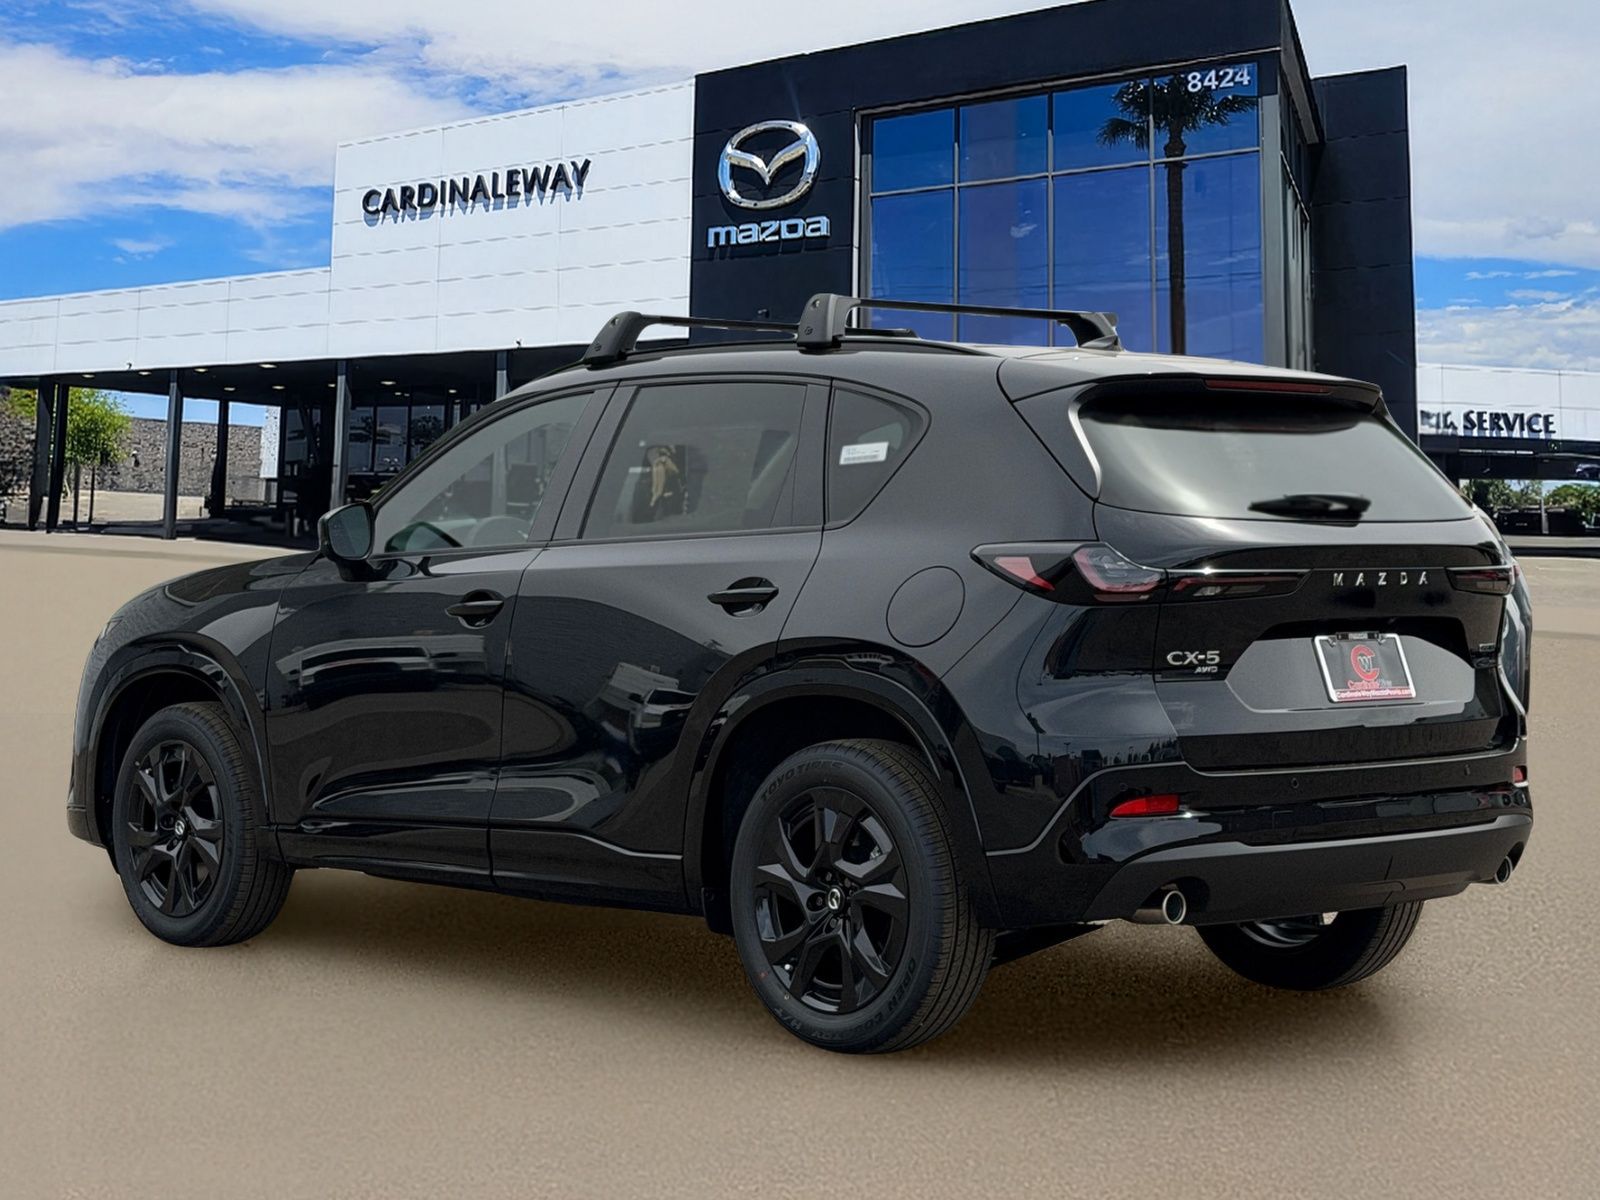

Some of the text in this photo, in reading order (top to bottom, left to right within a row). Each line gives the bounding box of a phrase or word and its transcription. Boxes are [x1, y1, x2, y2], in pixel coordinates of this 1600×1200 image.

[1187, 65, 1251, 93] 8424
[361, 158, 592, 218] CARDINALEWAY
[707, 215, 830, 248] mazda
[1462, 409, 1557, 434] SERVICE
[1332, 571, 1428, 586] MAZDA
[1166, 650, 1221, 666] CX-5
[1194, 665, 1219, 674] AWD
[760, 768, 795, 801] TOYO
